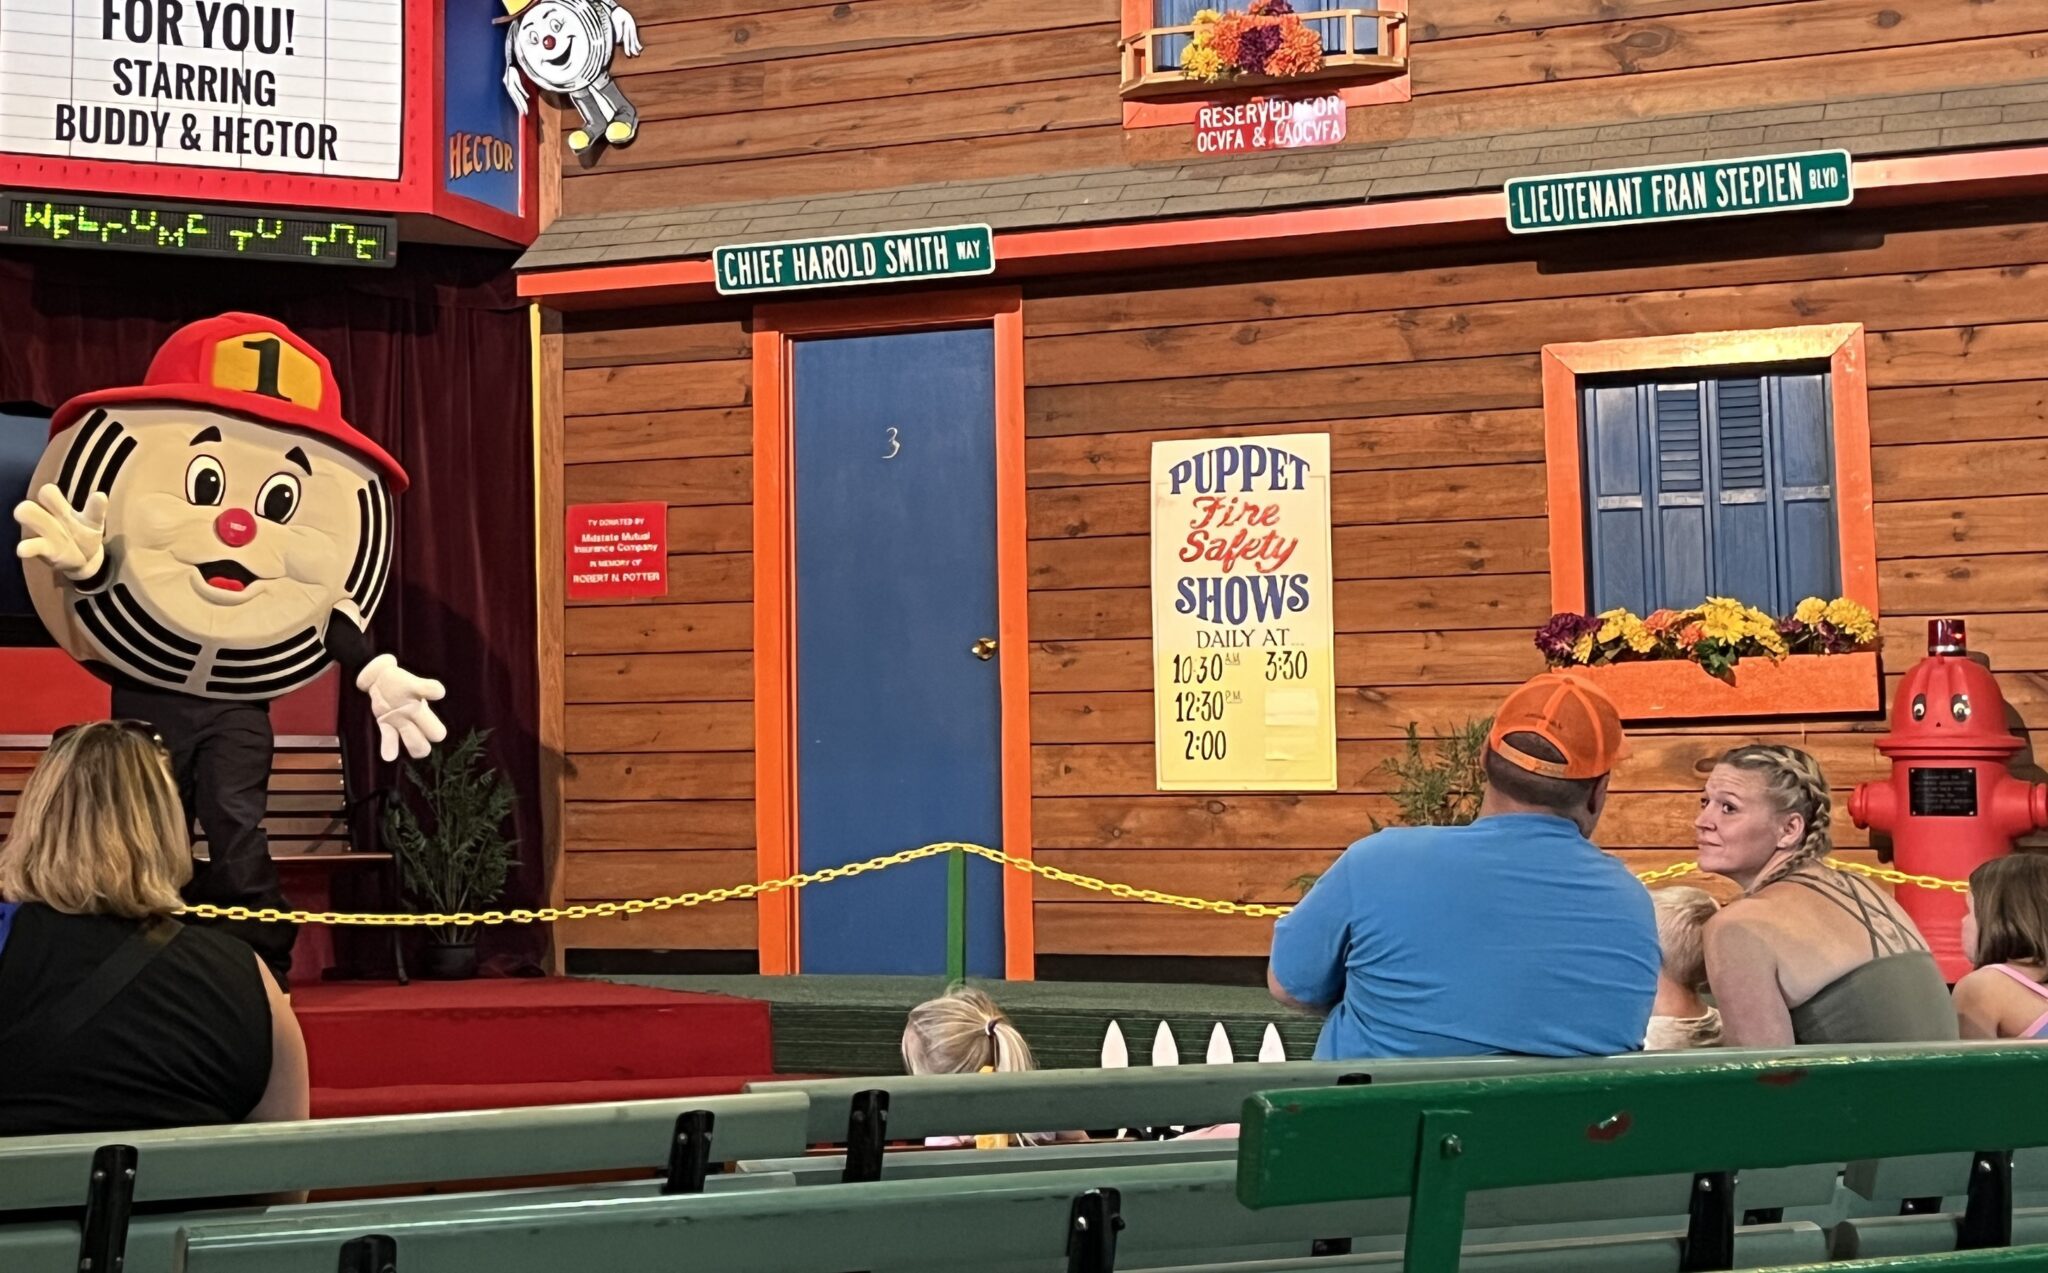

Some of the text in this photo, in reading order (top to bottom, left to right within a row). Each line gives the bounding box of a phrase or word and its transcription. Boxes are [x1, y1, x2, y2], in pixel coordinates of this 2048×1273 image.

[102, 0, 295, 56] FOR YOU!
[112, 58, 276, 107] STARRING
[55, 104, 338, 161] BUDDY & HECTOR
[1197, 129, 1245, 153] OCVFA
[1252, 126, 1267, 148] &
[449, 131, 514, 180] HECTOR
[1517, 161, 1839, 225] LIEUTENANT FRAN STEPIEN BLVD
[723, 234, 981, 287] CHIEF HAROLD SMITH WAY
[242, 338, 292, 402] 1
[881, 427, 900, 459] 3
[1169, 444, 1310, 495] PUPPET
[599, 518, 633, 526] DONATED
[1189, 496, 1281, 529] Fire
[573, 543, 659, 553] Insurance Company
[621, 531, 651, 541] Mutual
[1179, 528, 1298, 573] Safety
[573, 573, 608, 583] ROBERT
[622, 571, 660, 582] POTTER
[1175, 573, 1309, 625] SHOWS
[1197, 629, 1255, 648] DAILY
[1265, 650, 1308, 681] 3:30
[1175, 690, 1224, 722] 12:30
[1184, 730, 1227, 760] 2:00
